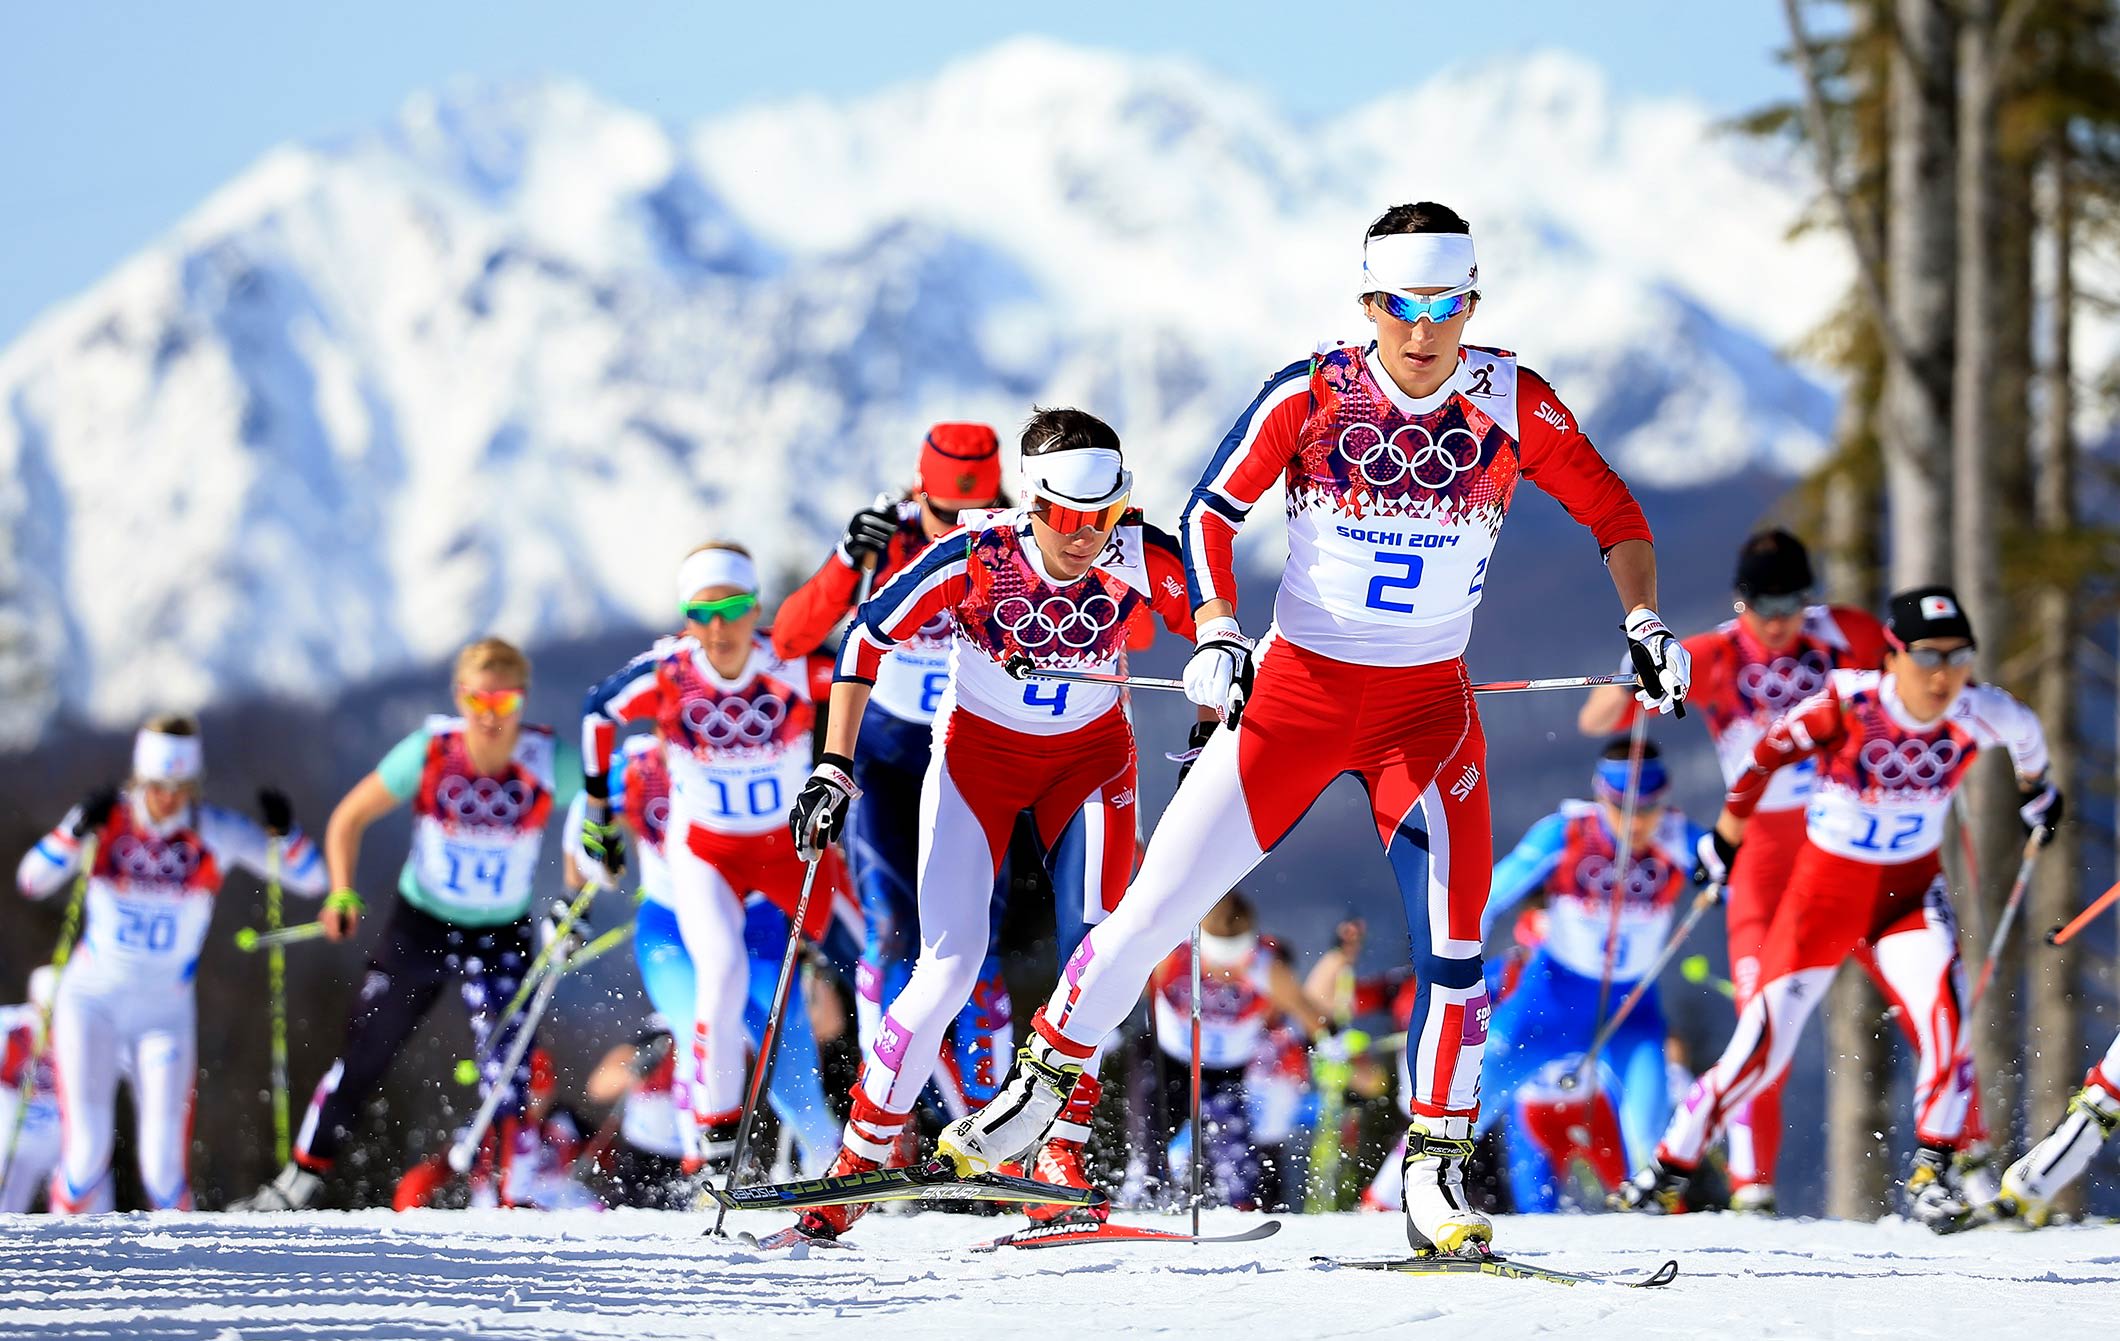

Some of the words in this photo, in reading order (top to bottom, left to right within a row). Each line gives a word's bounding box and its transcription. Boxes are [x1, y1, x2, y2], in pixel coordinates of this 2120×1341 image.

[1336, 525, 1402, 546] SOCHI
[1408, 533, 1460, 548] 2014
[1365, 551, 1424, 613] 2
[1468, 556, 1487, 596] 2
[1023, 683, 1070, 716] 4
[707, 777, 781, 816] 10
[1850, 812, 1924, 851] 12
[445, 850, 506, 895] 14
[116, 908, 176, 952] 20
[732, 1185, 779, 1200] FISCHER
[918, 1185, 982, 1200] FISCHER
